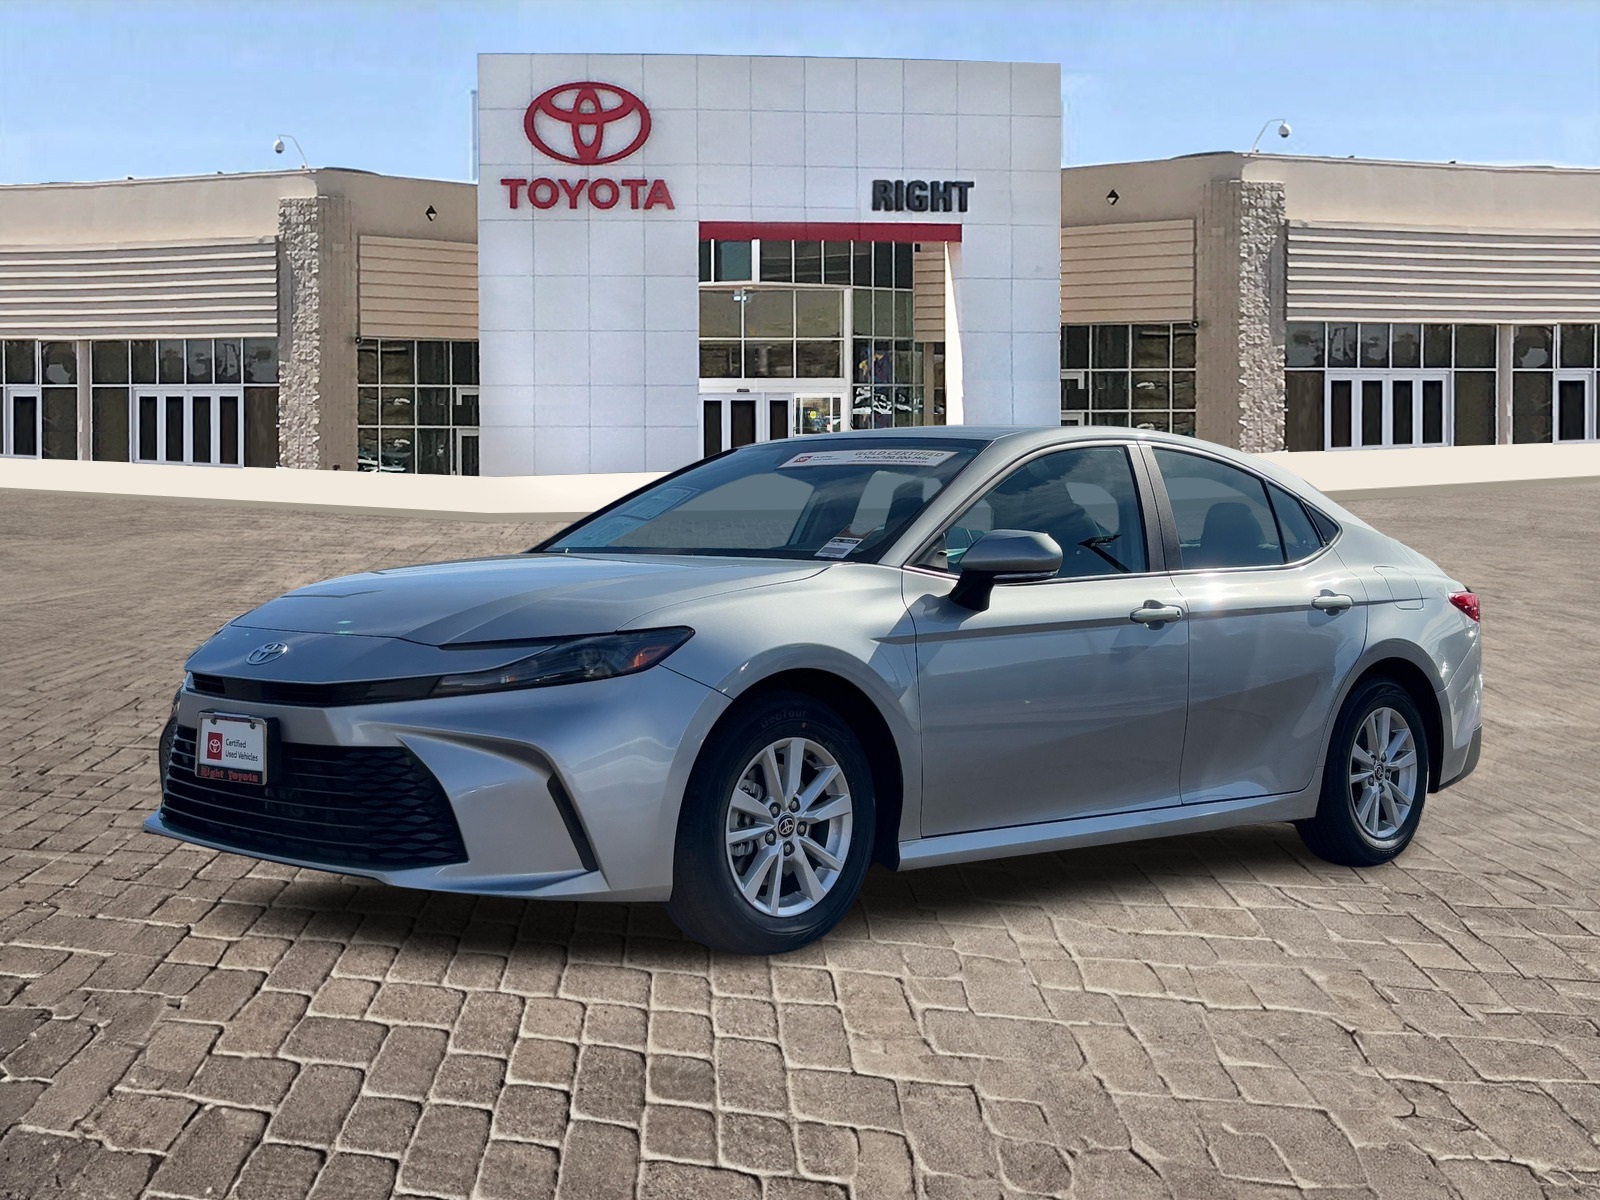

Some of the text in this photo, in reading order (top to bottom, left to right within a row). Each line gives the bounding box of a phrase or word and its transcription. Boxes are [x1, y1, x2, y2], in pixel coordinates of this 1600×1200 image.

[501, 179, 675, 210] TOYOTA
[872, 180, 975, 212] RIGHT
[225, 739, 247, 748] Certified
[225, 750, 259, 762] Used Vehicles
